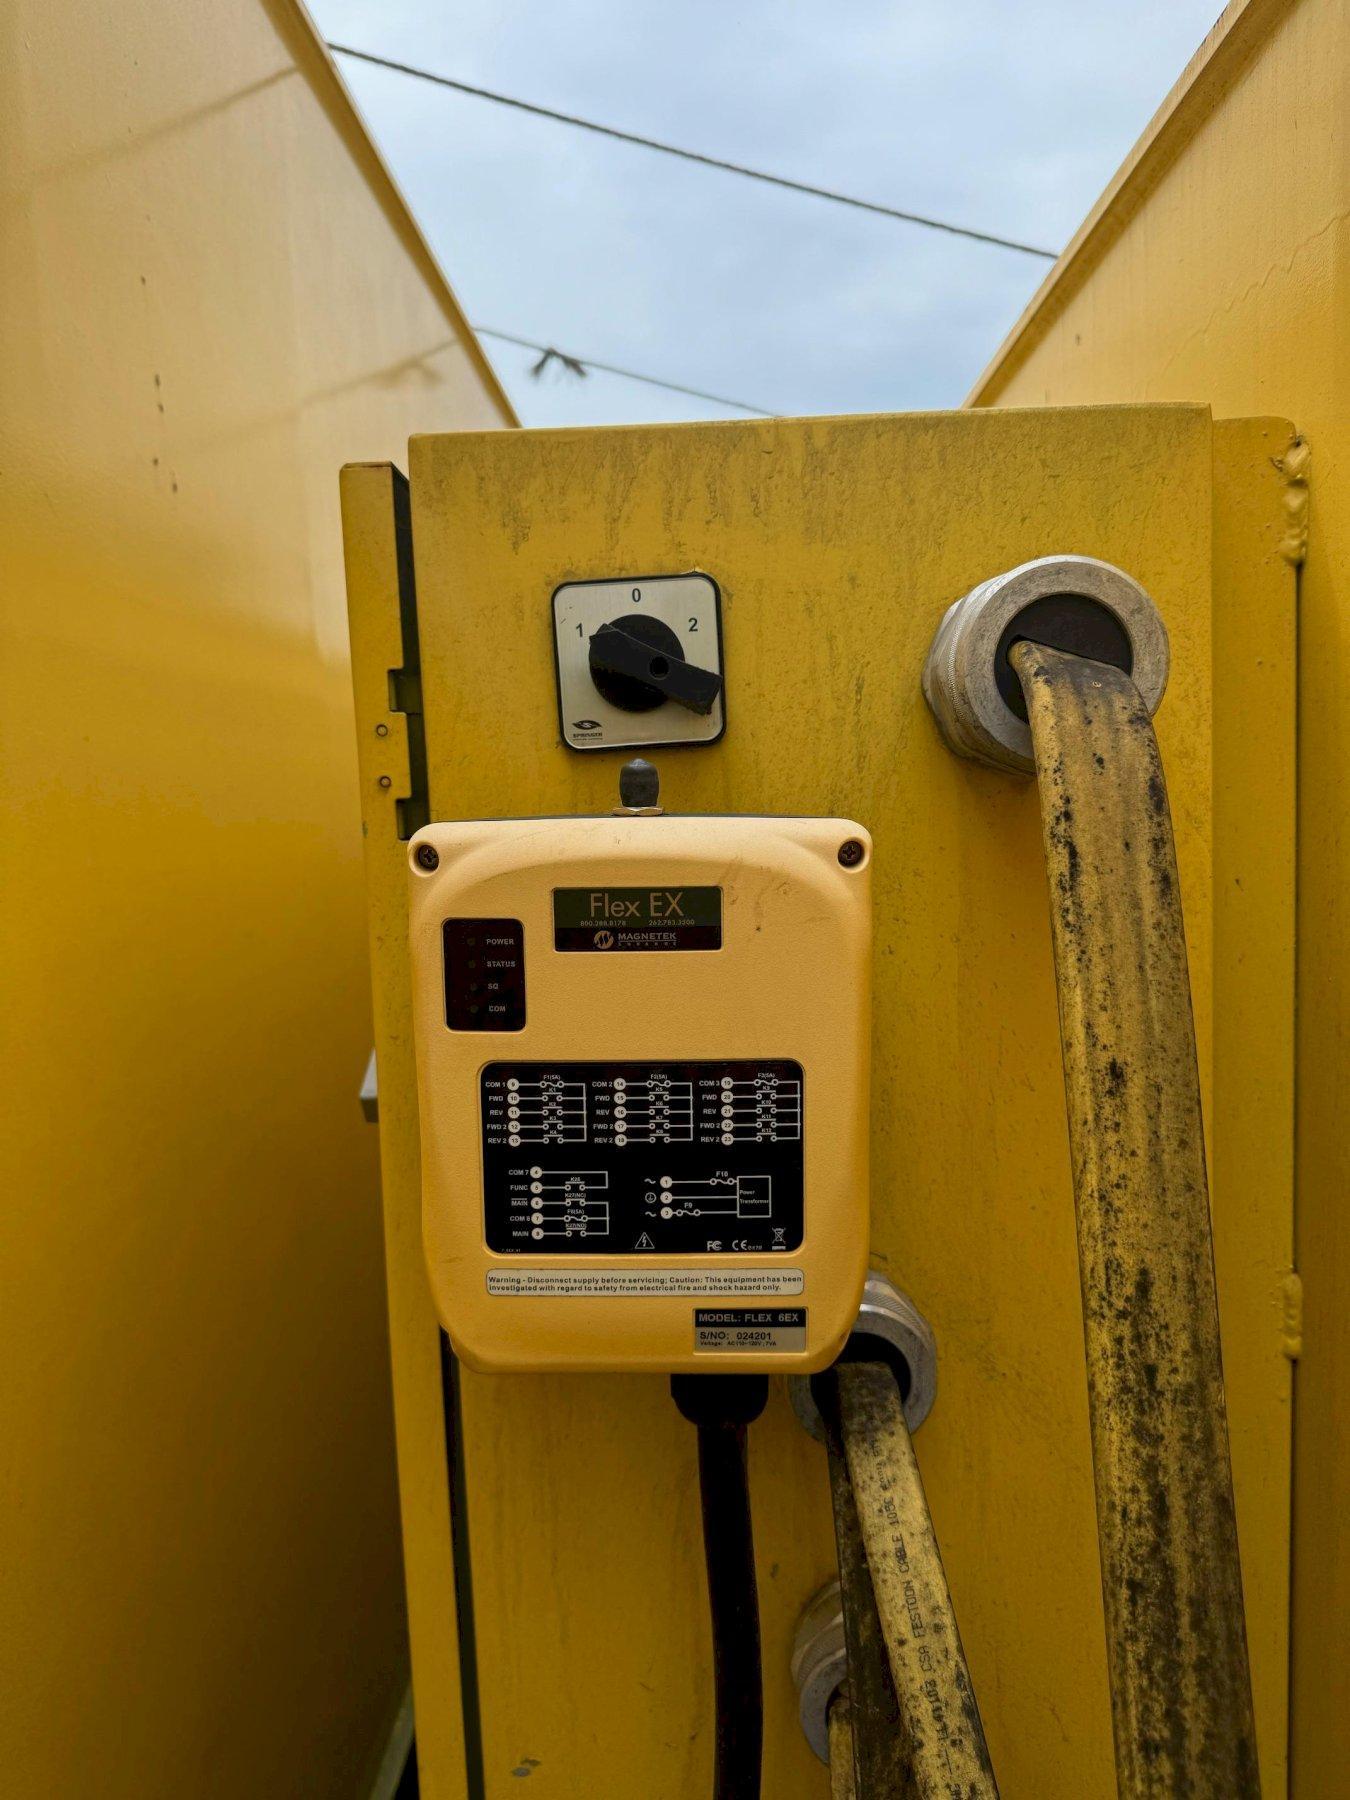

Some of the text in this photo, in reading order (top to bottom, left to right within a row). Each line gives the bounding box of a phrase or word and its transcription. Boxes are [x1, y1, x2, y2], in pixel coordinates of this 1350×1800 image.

[631, 588, 642, 603] 0
[575, 622, 583, 638] 1
[688, 617, 699, 632] 2
[590, 892, 684, 918] Flex EX
[618, 932, 677, 940] MAGNETEK
[488, 1276, 521, 1284] Warning
[527, 1276, 572, 1284] Disconnect
[573, 1276, 600, 1285] supply
[601, 1276, 627, 1284] before
[669, 1276, 703, 1284] Caution:
[723, 1276, 765, 1285] equipment
[782, 1275, 802, 1283] been
[489, 1284, 538, 1292] investigated
[557, 1284, 583, 1293] regard
[593, 1284, 618, 1293] safety
[762, 1284, 782, 1292] only.
[698, 1313, 799, 1322] MODEL: FLEX 6EX
[700, 1331, 771, 1340] S/NO: 024201
[902, 1579, 926, 1639] FESTOON
